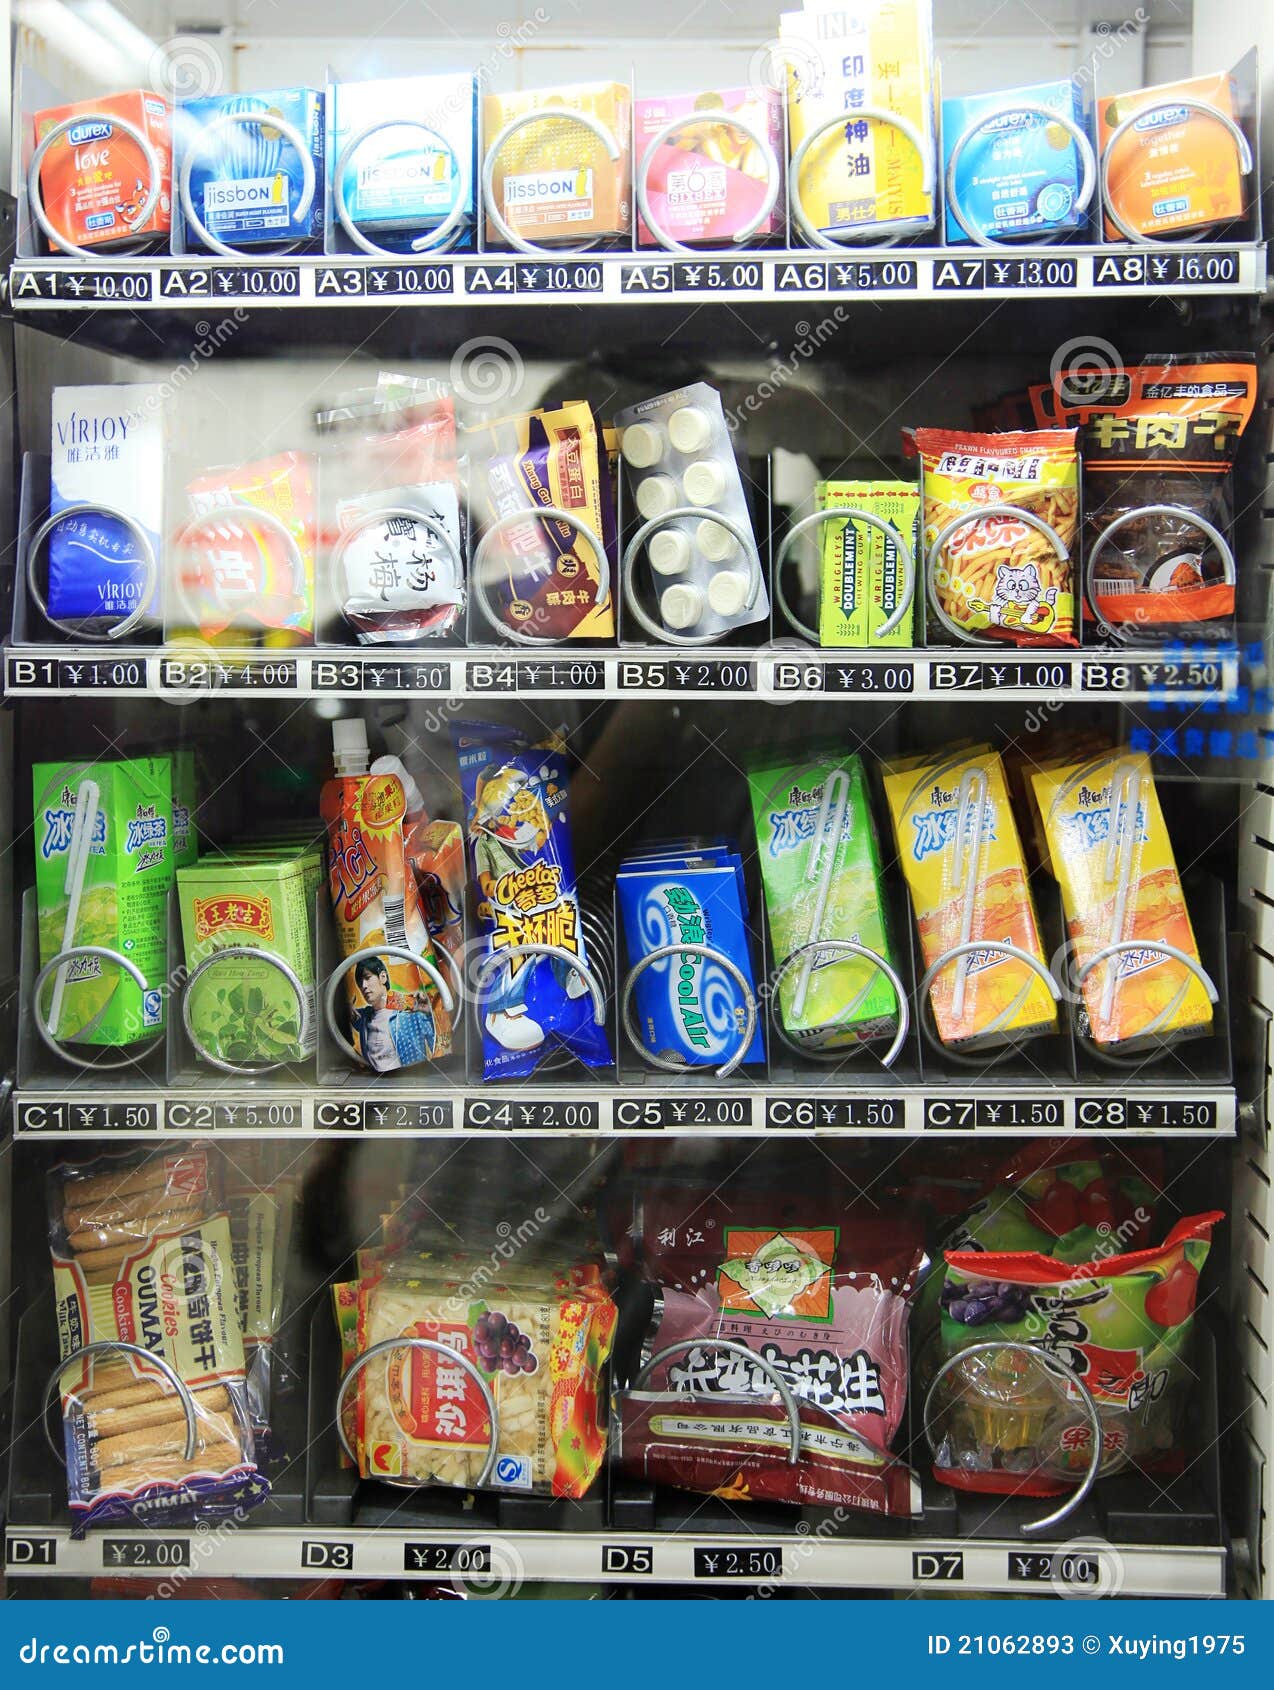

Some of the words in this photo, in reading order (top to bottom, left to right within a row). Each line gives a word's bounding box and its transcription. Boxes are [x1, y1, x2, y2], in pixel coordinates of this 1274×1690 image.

[842, 55, 871, 178] 印度神油
[71, 123, 110, 140] durex
[74, 149, 111, 170] love
[469, 268, 514, 291] A4
[625, 266, 670, 289] A5
[779, 265, 824, 288] A6
[935, 262, 983, 286] A7
[1097, 258, 1144, 281] A8
[18, 273, 57, 296] A1
[164, 271, 208, 294] A2
[318, 270, 362, 294] A3
[57, 412, 131, 446] VÍRJOY
[1089, 411, 1244, 450] 牛肉干
[67, 447, 120, 463] 唯洁雅
[568, 437, 584, 501] 大豆蛋白
[523, 461, 542, 488] Xiang
[537, 488, 552, 507] Gu
[833, 534, 842, 605] WRIGLEY'S
[843, 527, 857, 611] DOUBLEMINT
[884, 534, 897, 610] DOUBLEMIN
[98, 580, 142, 600] VÍRJOY
[546, 589, 590, 607] 牛肉味
[15, 664, 53, 684] B1
[165, 664, 207, 684] B2
[317, 666, 359, 686] B3
[473, 666, 515, 687] B4
[623, 666, 665, 687] B5
[779, 667, 823, 688] B6
[935, 666, 983, 688] B7
[1086, 666, 1131, 688] B8
[127, 819, 167, 853] 冰绿茶
[496, 863, 561, 905] Cheetos
[516, 884, 558, 912] 奇多
[211, 903, 256, 925] 王老吉
[663, 886, 703, 946] 劲浪
[678, 950, 702, 1006] Cool
[679, 1007, 710, 1049] Air
[24, 1107, 65, 1128] C1
[168, 1106, 213, 1127] C2
[317, 1103, 361, 1126] C3
[469, 1102, 512, 1126] C4
[617, 1103, 662, 1125] C5
[770, 1102, 813, 1125] C6
[928, 1103, 973, 1125] C7
[1079, 1102, 1125, 1125] C8
[658, 1227, 705, 1248] 利江
[57, 1300, 69, 1328] Milk
[115, 1286, 130, 1343] Cookies
[160, 1273, 181, 1337] Cookies
[435, 1331, 468, 1437] 沙琪玛
[75, 1413, 86, 1432] NET
[12, 1541, 52, 1561] D1
[306, 1545, 349, 1567] D3
[606, 1548, 650, 1571] D5
[917, 1557, 961, 1578] D7
